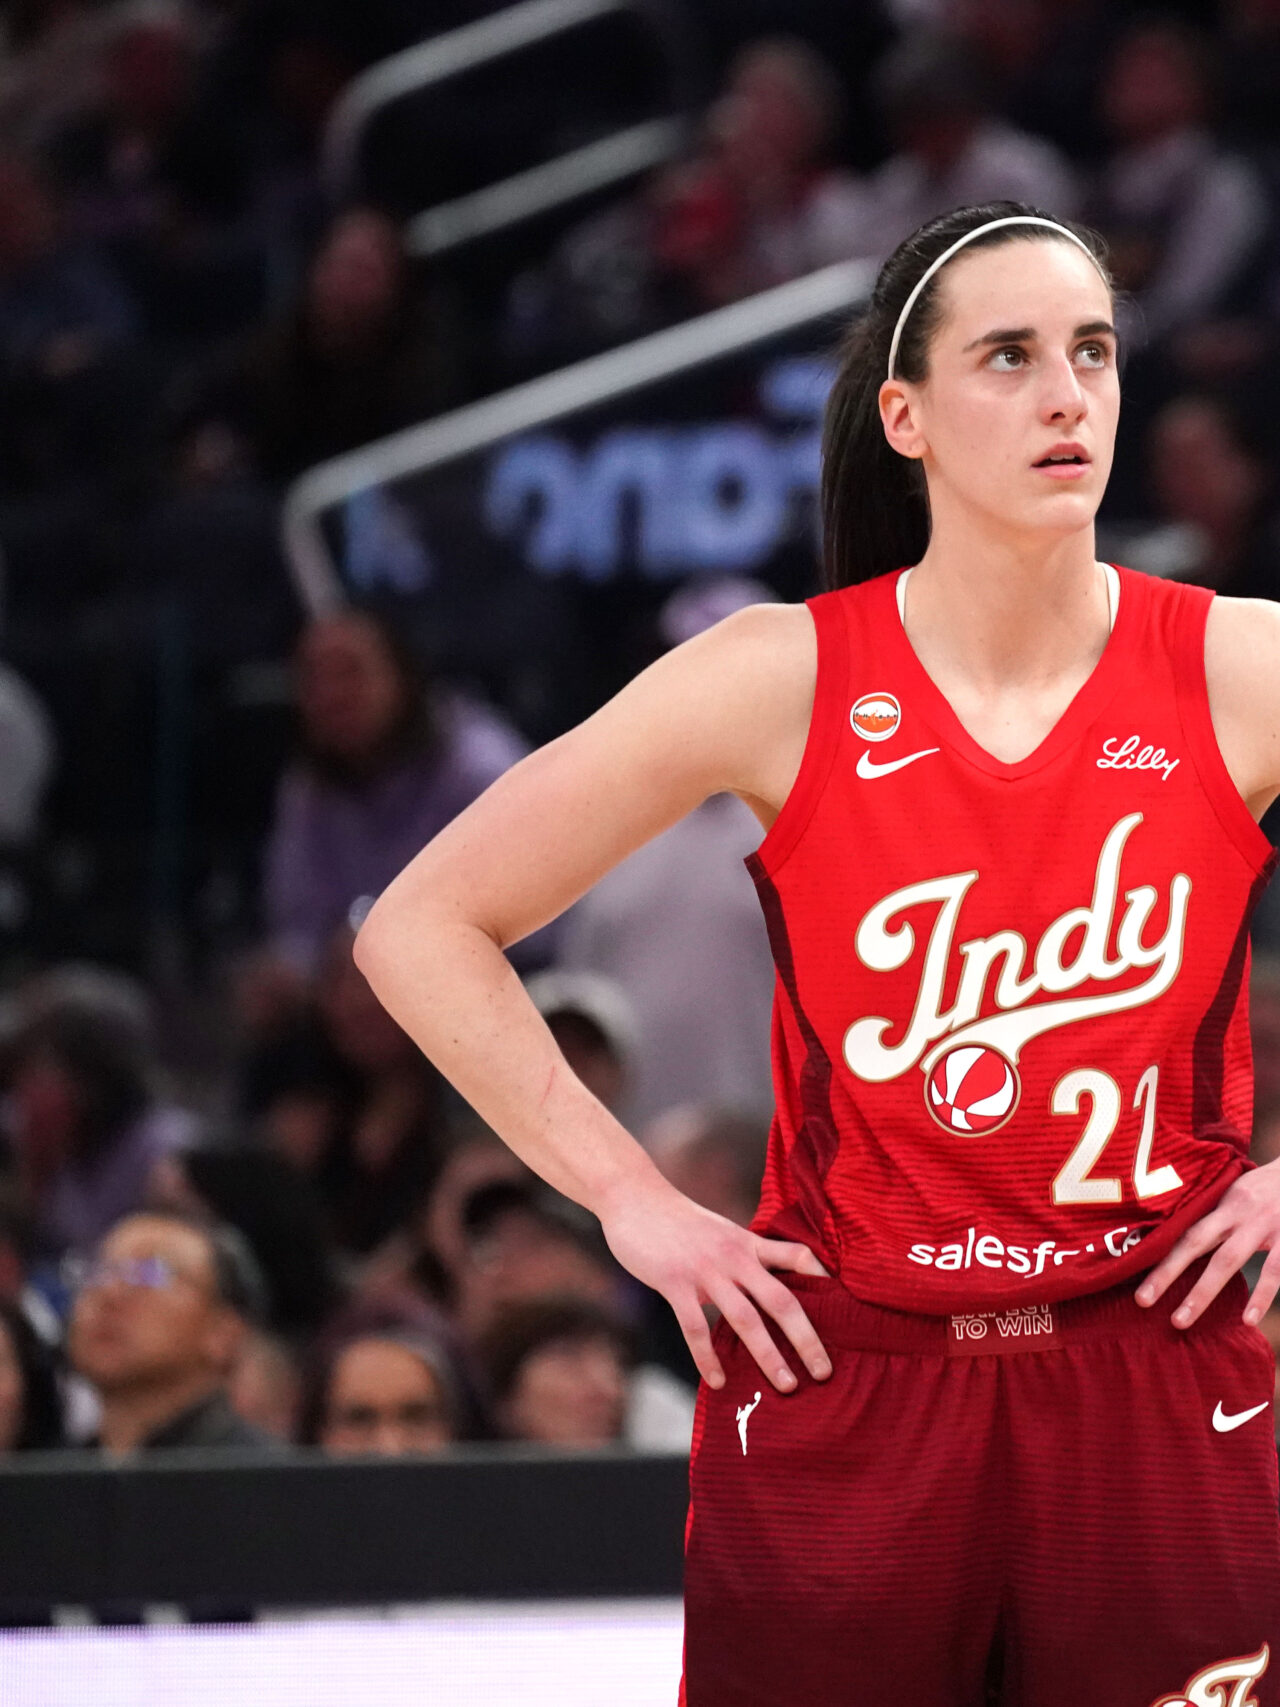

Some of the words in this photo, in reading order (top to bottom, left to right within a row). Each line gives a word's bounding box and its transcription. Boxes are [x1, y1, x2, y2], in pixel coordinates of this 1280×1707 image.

[1096, 735, 1180, 781] Lilly
[842, 812, 1192, 1082] Indy
[1051, 1064, 1184, 1205] 22
[952, 1320, 987, 1340] TO
[995, 1314, 1053, 1337] WIN
